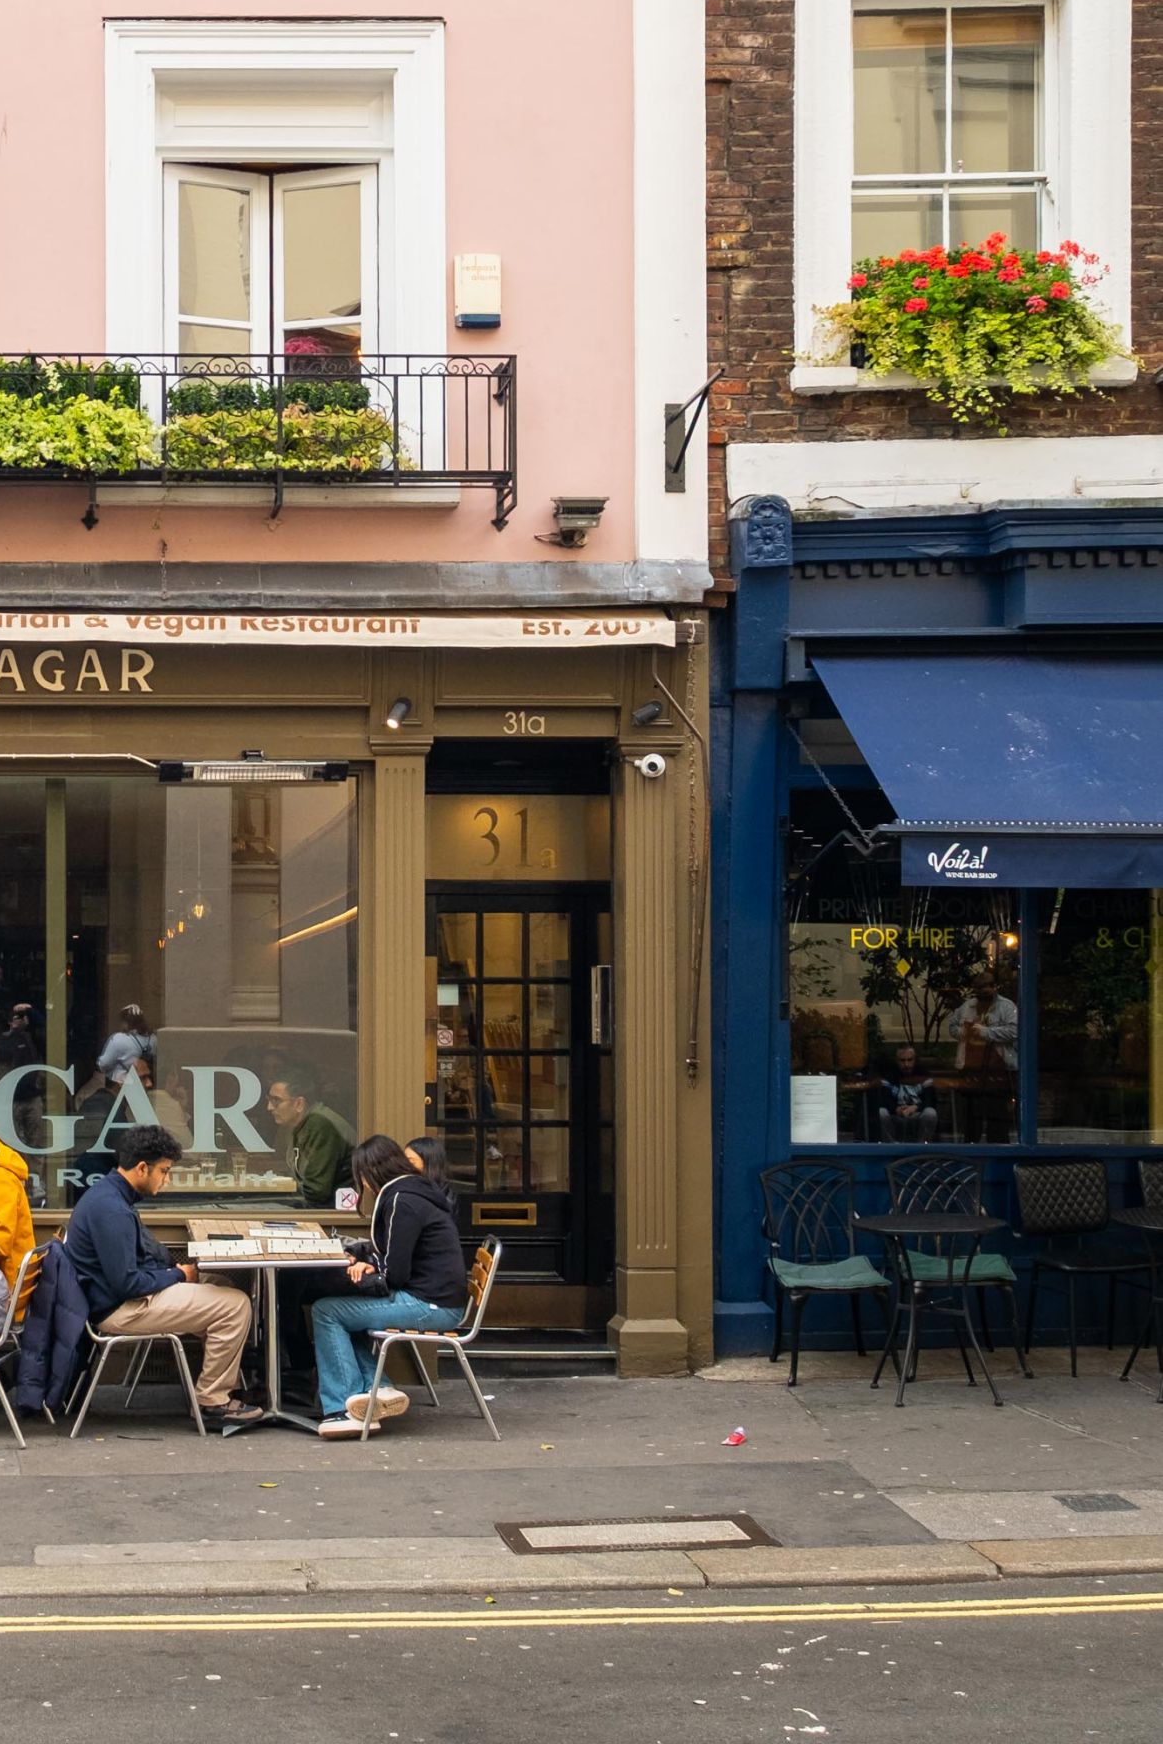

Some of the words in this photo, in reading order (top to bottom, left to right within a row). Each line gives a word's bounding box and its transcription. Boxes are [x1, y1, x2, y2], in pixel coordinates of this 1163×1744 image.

[84, 615, 110, 629] &
[125, 615, 227, 638] Vegan
[239, 617, 421, 634] Restaurant
[583, 620, 656, 637] 200
[503, 711, 546, 735] 31a
[945, 871, 964, 879] WINE
[913, 897, 989, 920] OOM
[850, 927, 899, 949] FOR
[907, 928, 956, 949] HIRE
[1095, 927, 1115, 949] &
[56, 1168, 278, 1188] Reurant
